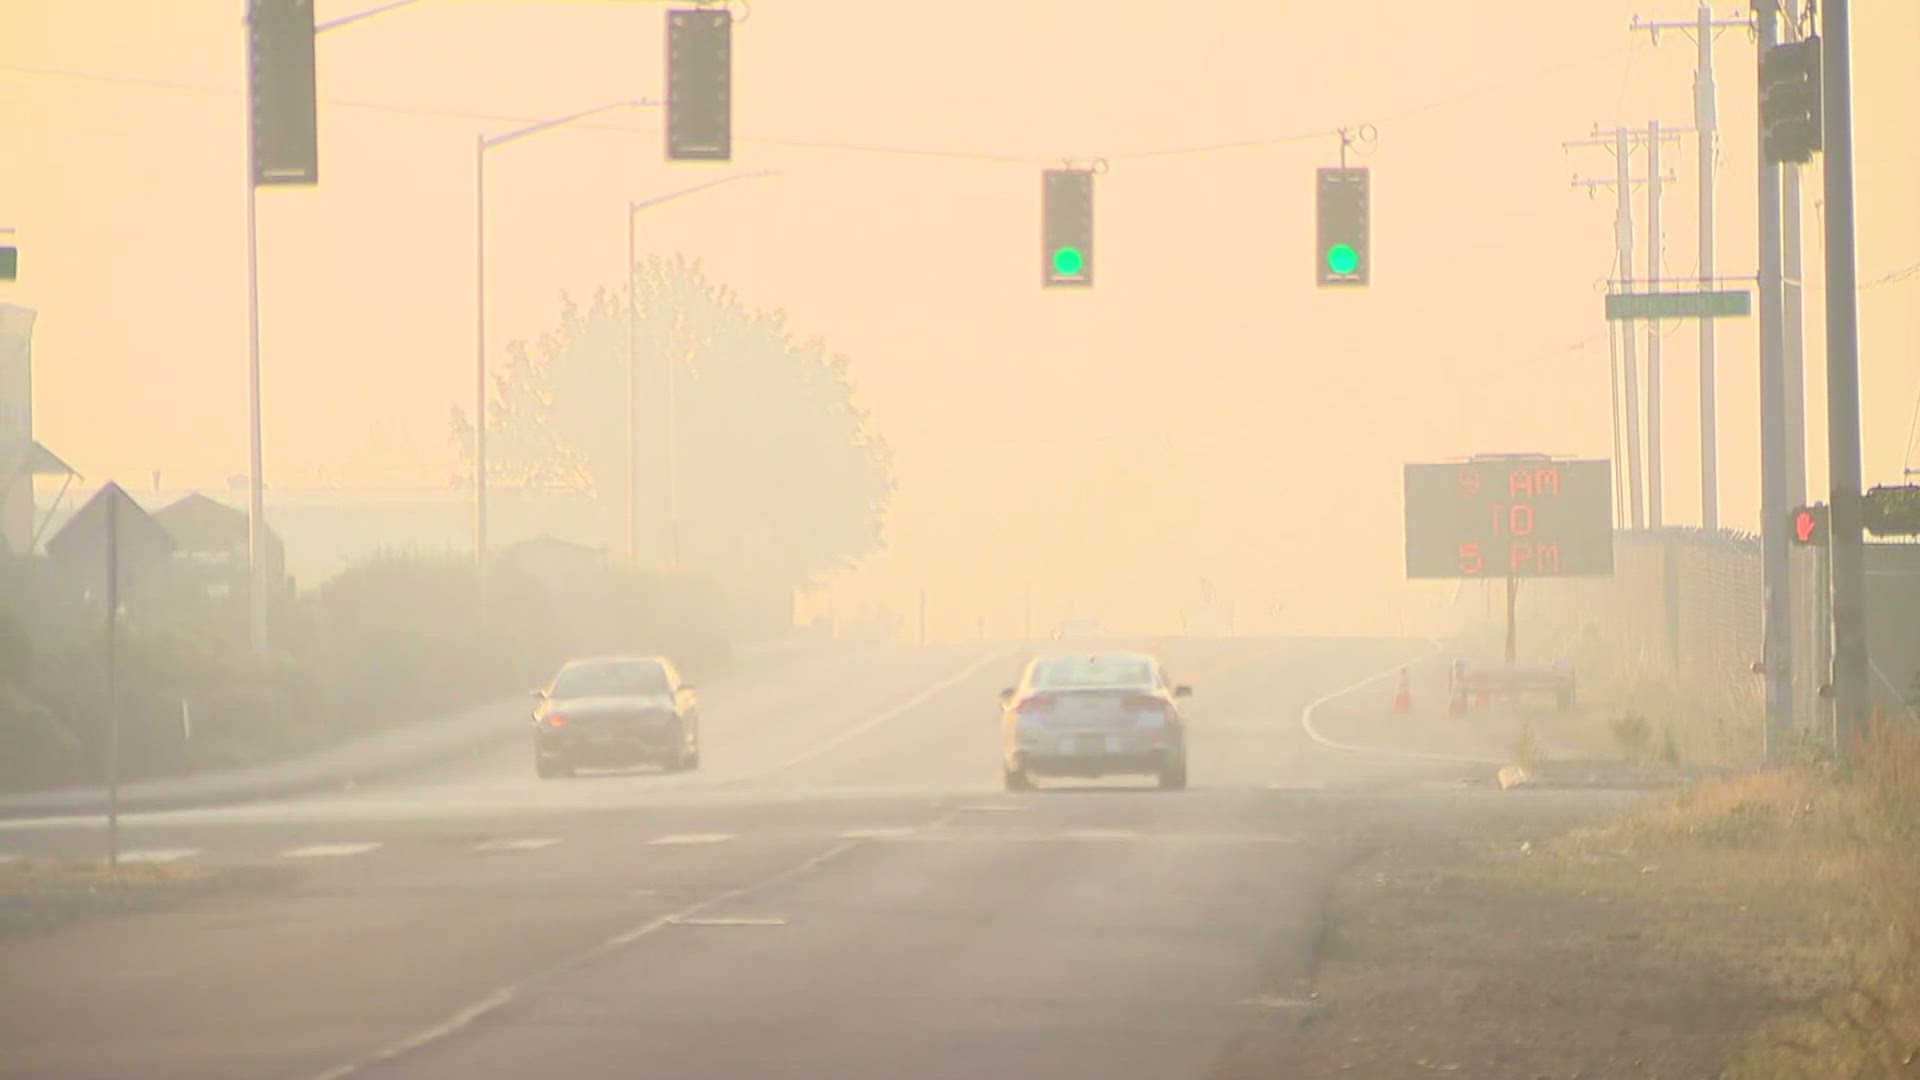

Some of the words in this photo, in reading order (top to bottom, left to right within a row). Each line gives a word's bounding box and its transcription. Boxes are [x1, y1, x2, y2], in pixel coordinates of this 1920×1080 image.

[1508, 466, 1560, 497] AM
[1490, 502, 1536, 537] TO
[1458, 541, 1484, 575] 5
[1509, 541, 1560, 574] PM
